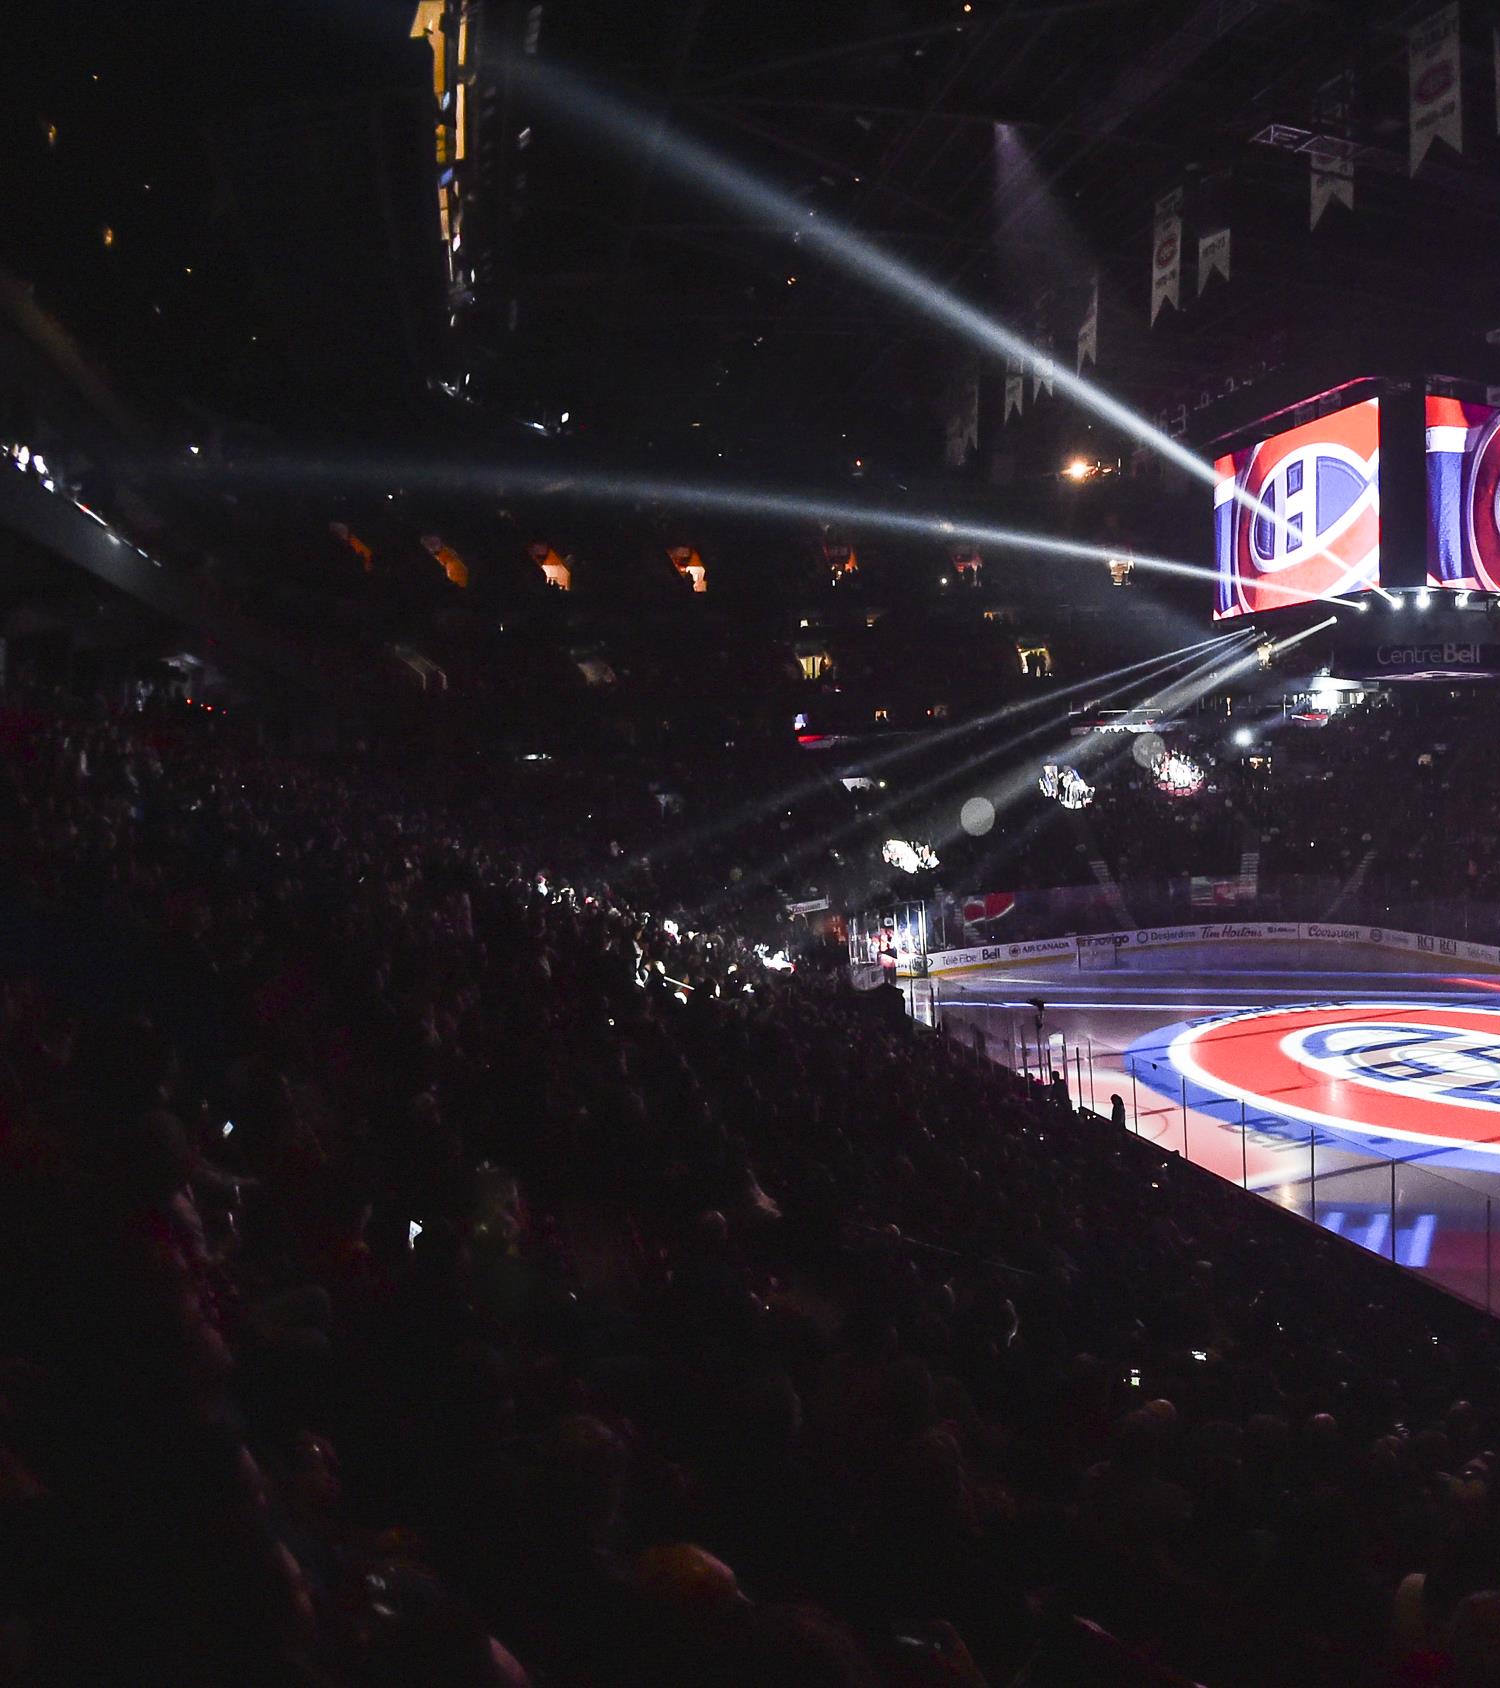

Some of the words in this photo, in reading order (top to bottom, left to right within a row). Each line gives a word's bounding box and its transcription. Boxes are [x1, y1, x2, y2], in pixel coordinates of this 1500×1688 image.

[981, 946, 1001, 961] Bell
[1022, 945, 1036, 953] AIR
[1036, 941, 1070, 953] CANADA
